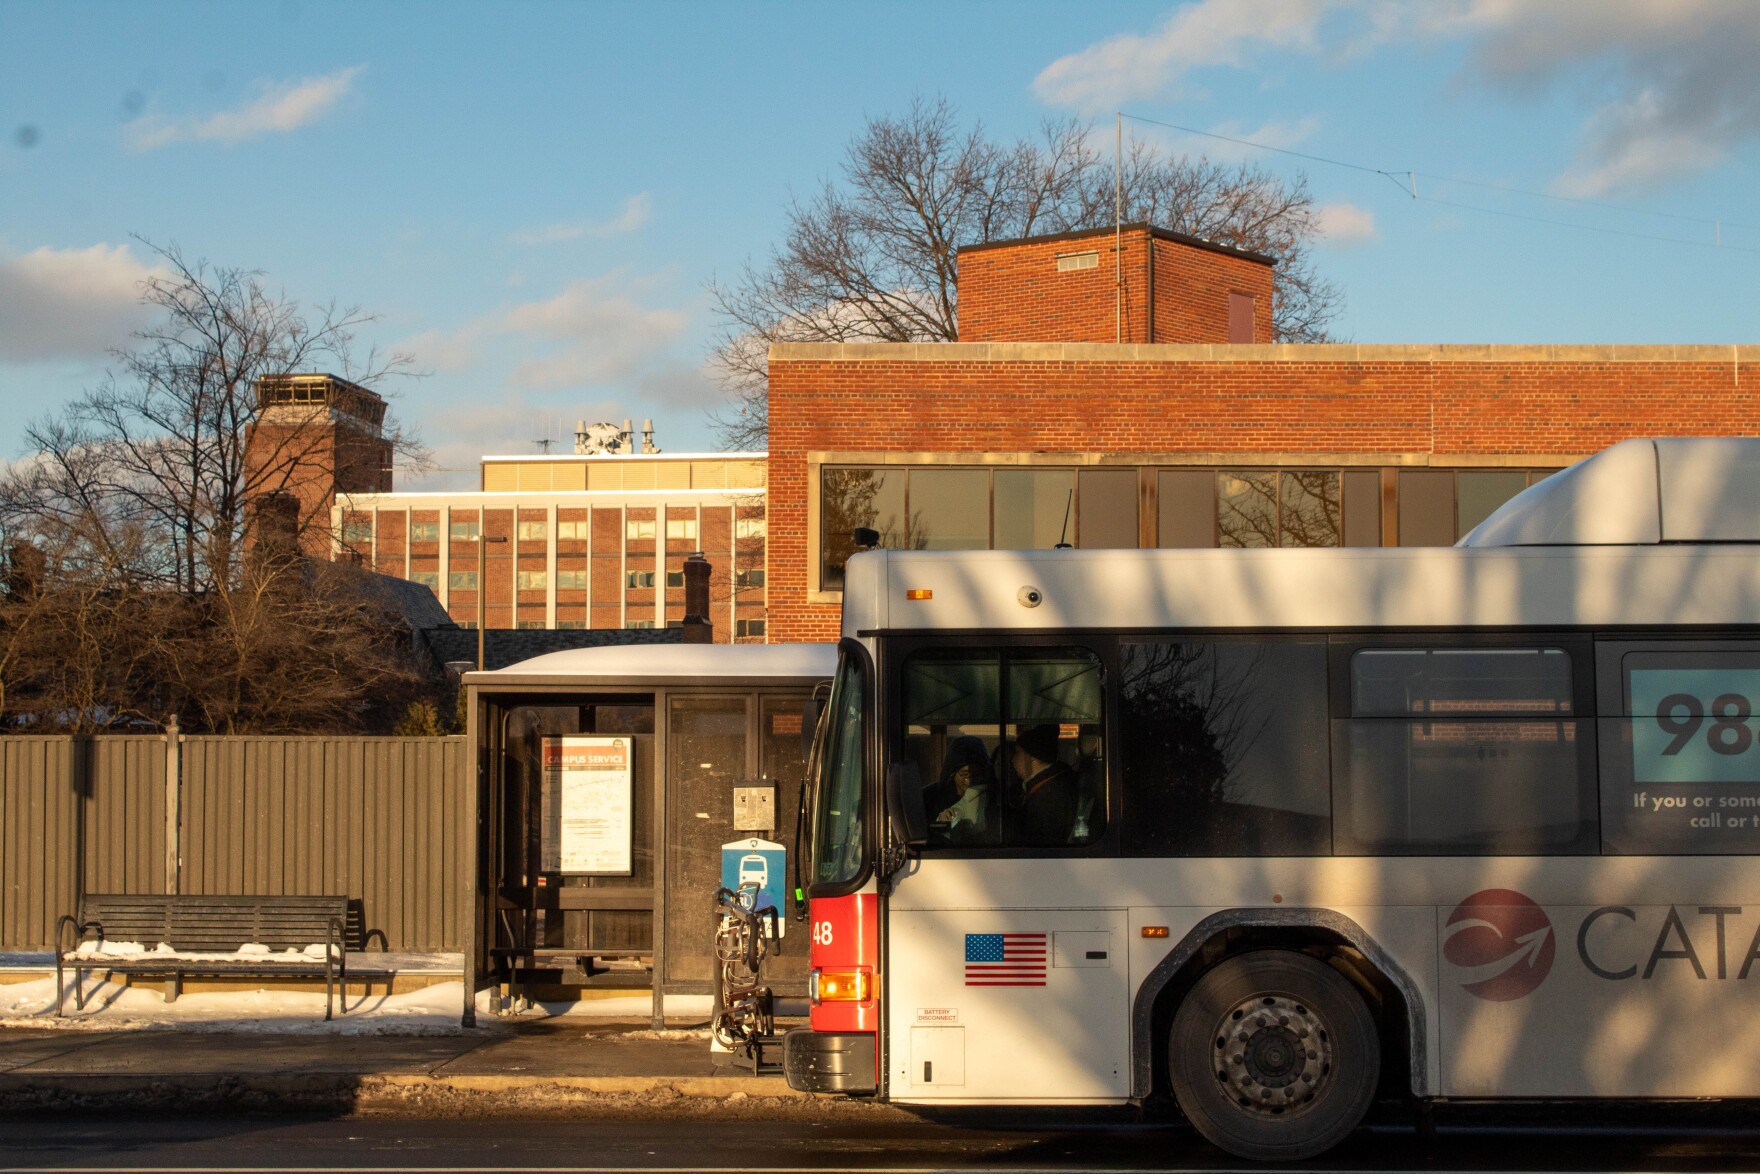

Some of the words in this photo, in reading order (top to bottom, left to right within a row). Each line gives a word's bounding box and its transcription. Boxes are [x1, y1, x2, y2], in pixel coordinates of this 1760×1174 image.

[1656, 693, 1760, 755] 98
[547, 755, 586, 764] CAMPUS
[588, 755, 623, 764] SERVICE
[1634, 792, 1647, 808] If
[1652, 796, 1687, 812] you
[1693, 796, 1713, 808] or
[1719, 796, 1760, 808] som
[1690, 812, 1721, 828] call
[1727, 816, 1747, 828] or
[813, 921, 833, 945] 48
